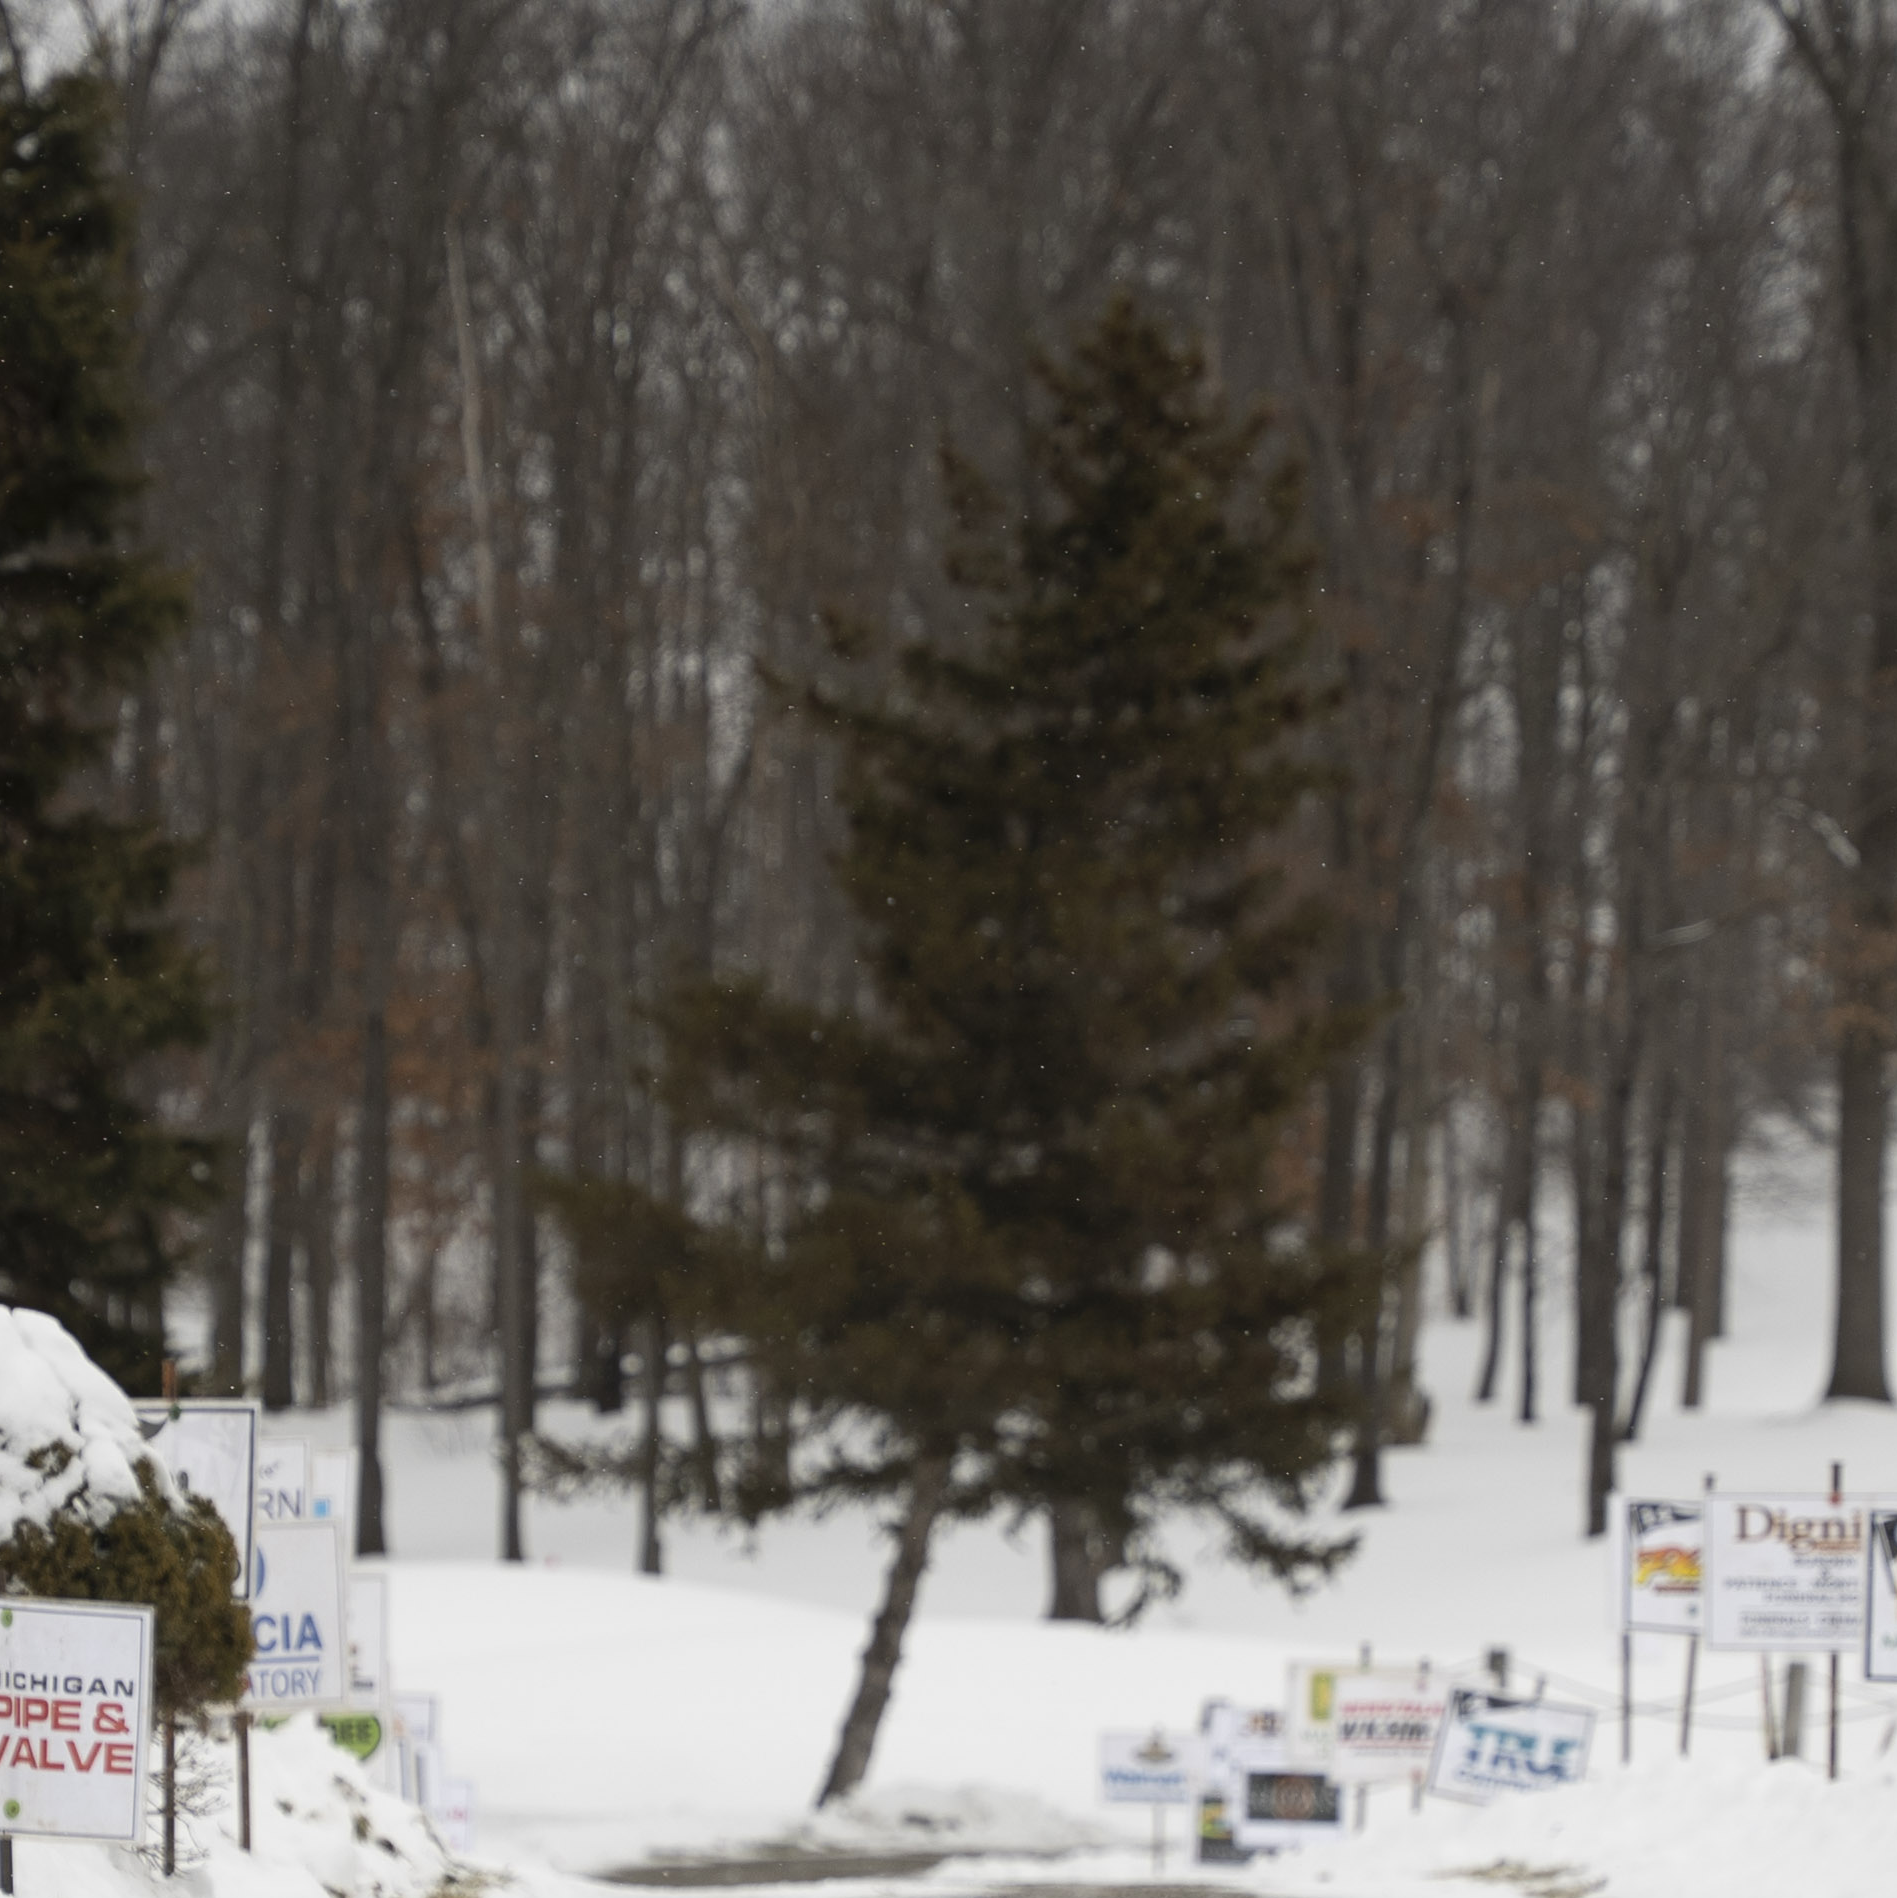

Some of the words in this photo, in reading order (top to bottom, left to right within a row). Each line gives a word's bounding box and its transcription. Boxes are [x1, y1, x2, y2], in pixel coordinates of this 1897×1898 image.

[1735, 1503, 1861, 1554] Digni
[252, 1612, 322, 1653] CIA
[93, 1702, 130, 1734] &
